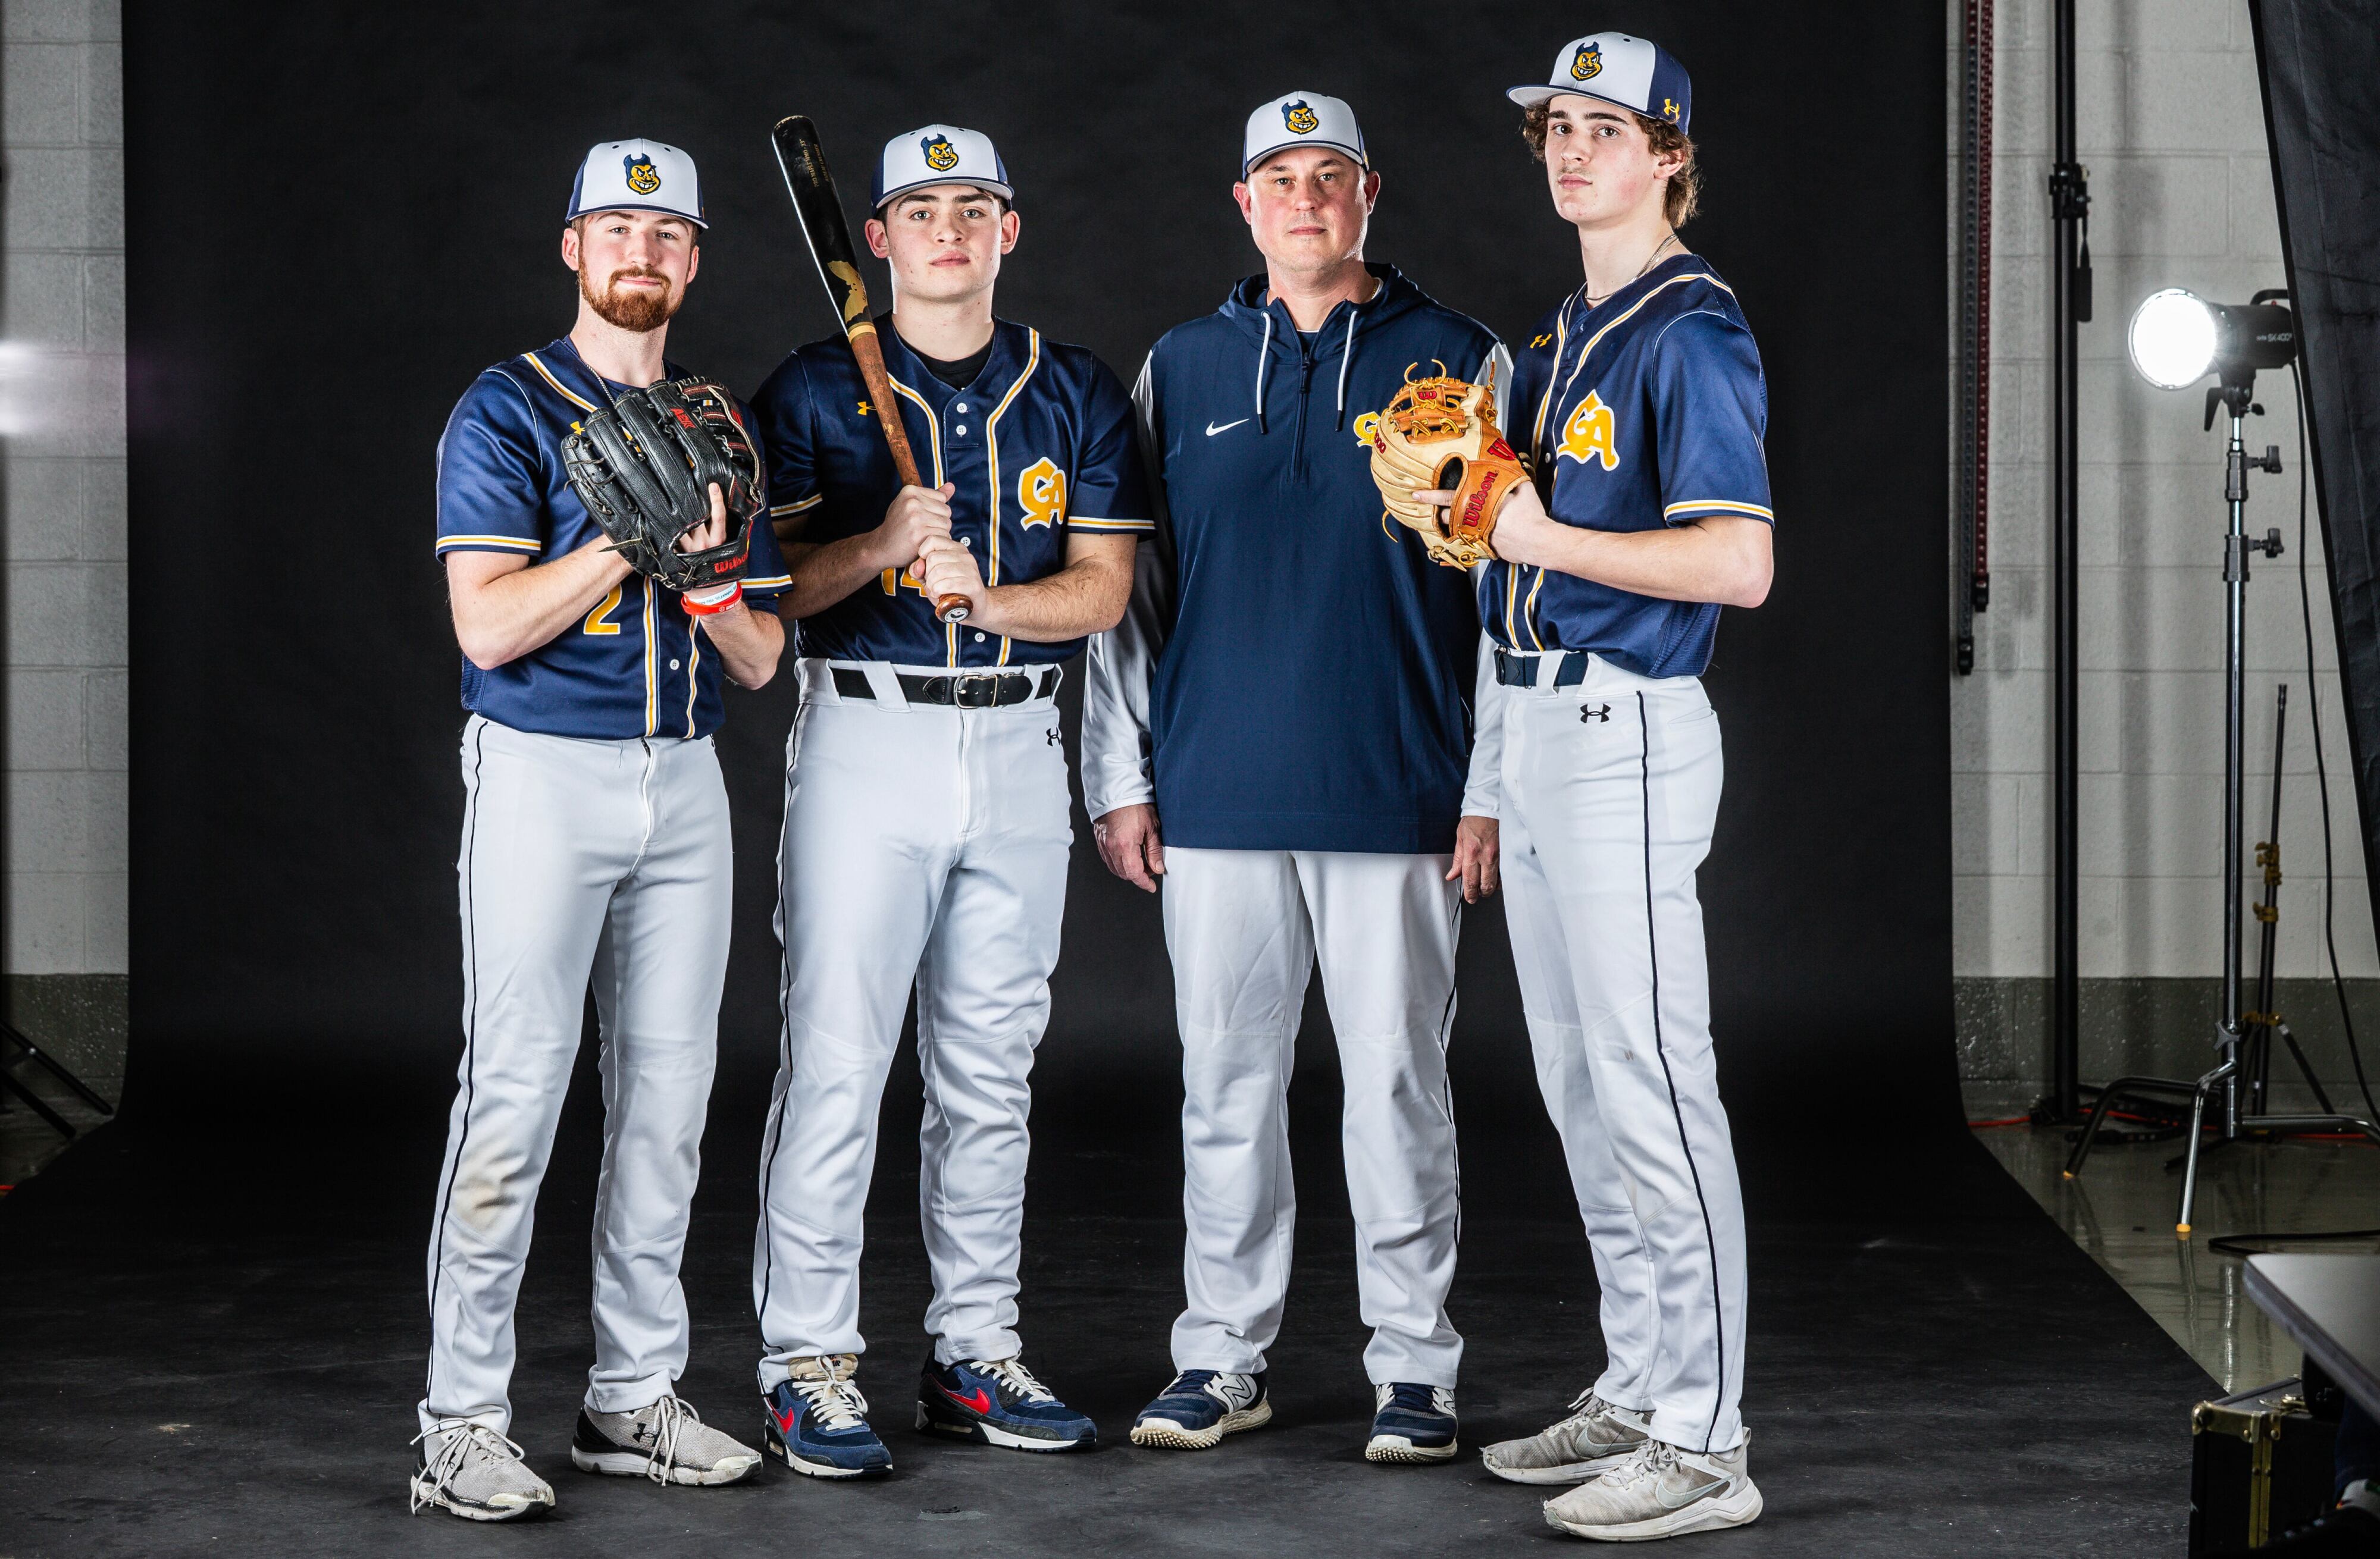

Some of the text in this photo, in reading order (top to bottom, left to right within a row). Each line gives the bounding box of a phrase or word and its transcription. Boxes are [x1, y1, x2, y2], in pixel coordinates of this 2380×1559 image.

[1353, 411, 1381, 447] G
[1557, 388, 1620, 471] GA
[1018, 456, 1067, 531] GA
[1462, 470, 1499, 528] Wilson
[714, 553, 749, 574] Wilso
[583, 583, 622, 635] 2
